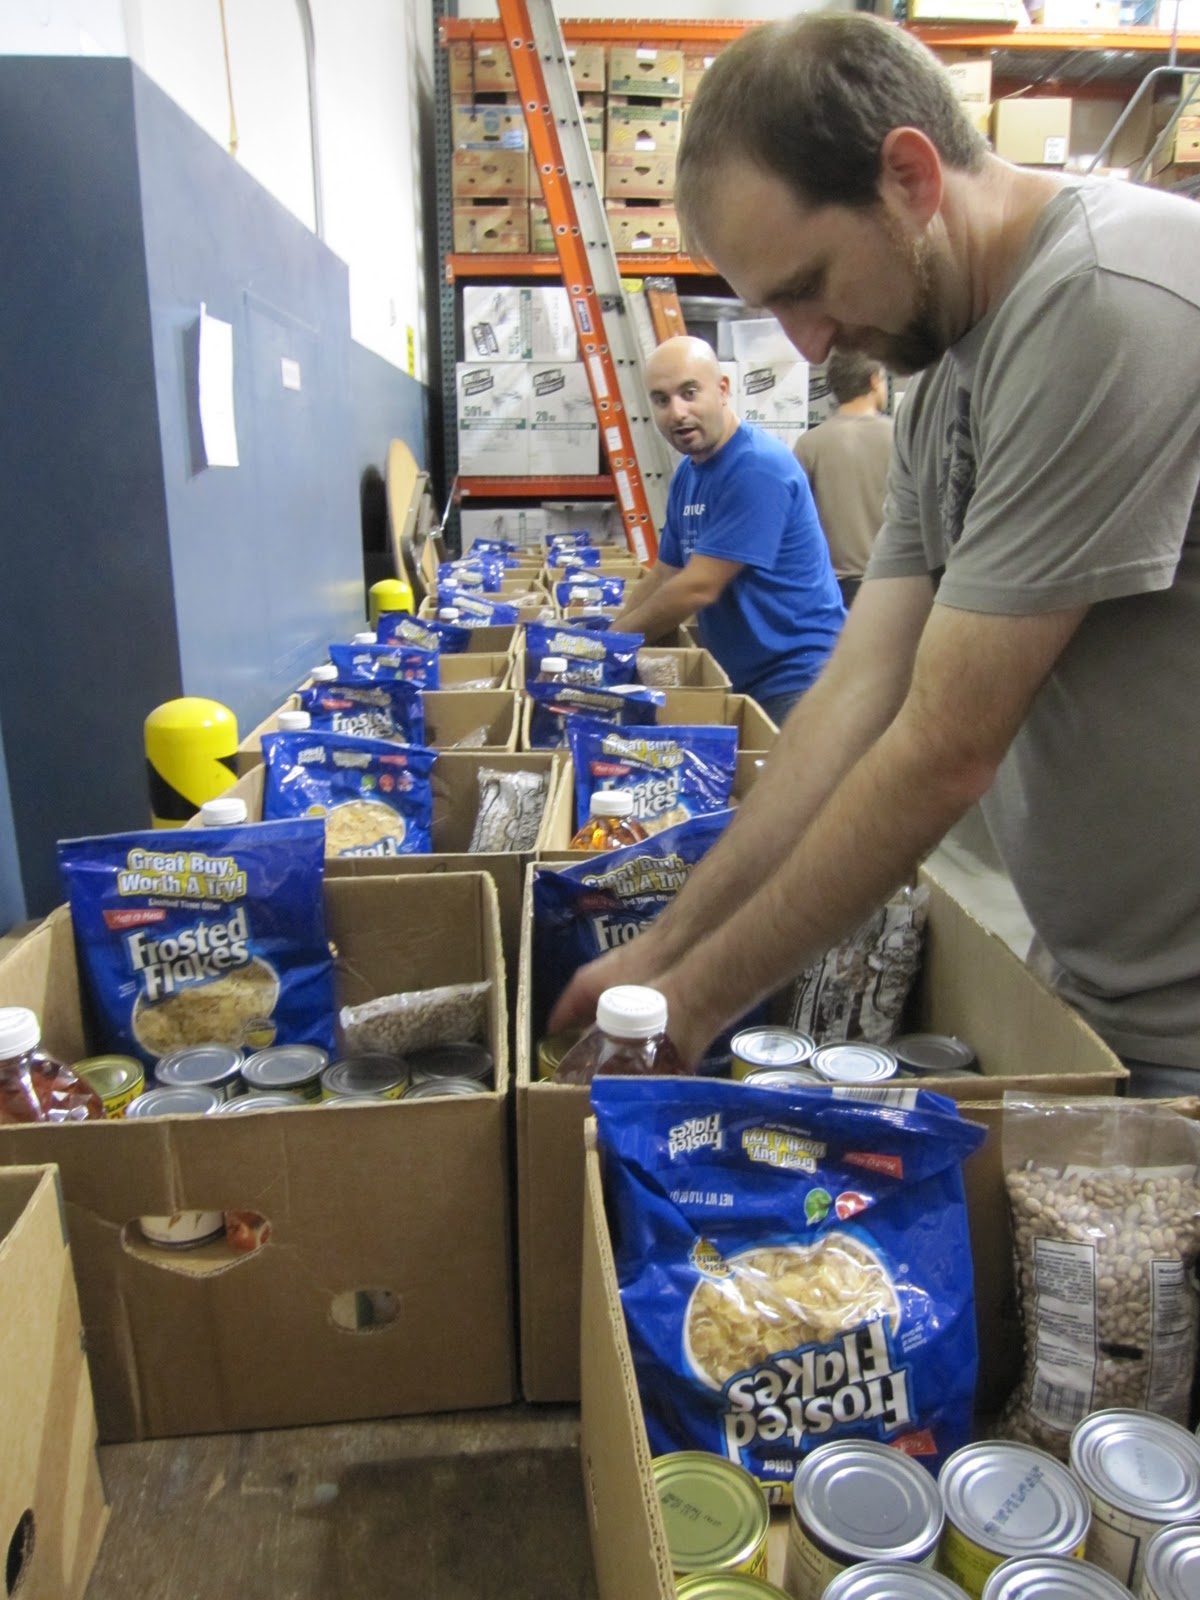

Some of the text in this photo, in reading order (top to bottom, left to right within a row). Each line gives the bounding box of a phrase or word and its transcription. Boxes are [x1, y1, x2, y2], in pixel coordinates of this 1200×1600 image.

[131, 851, 235, 879] Great Buy,
[120, 873, 243, 898] Worth A Try!
[126, 906, 249, 971] Frosted
[143, 940, 250, 1002] Flakes
[669, 1113, 720, 1143] Flakes
[742, 1128, 770, 1148] Try!
[773, 1134, 783, 1148] A
[668, 1130, 723, 1161] Frosted
[749, 1144, 817, 1174] Great Buy,
[786, 1136, 827, 1159] Worth
[704, 1192, 718, 1206] WT
[718, 1193, 734, 1207] NET
[727, 1314, 892, 1413] Flakes
[725, 1369, 911, 1464] Frosted
[762, 1459, 793, 1474] Offer
